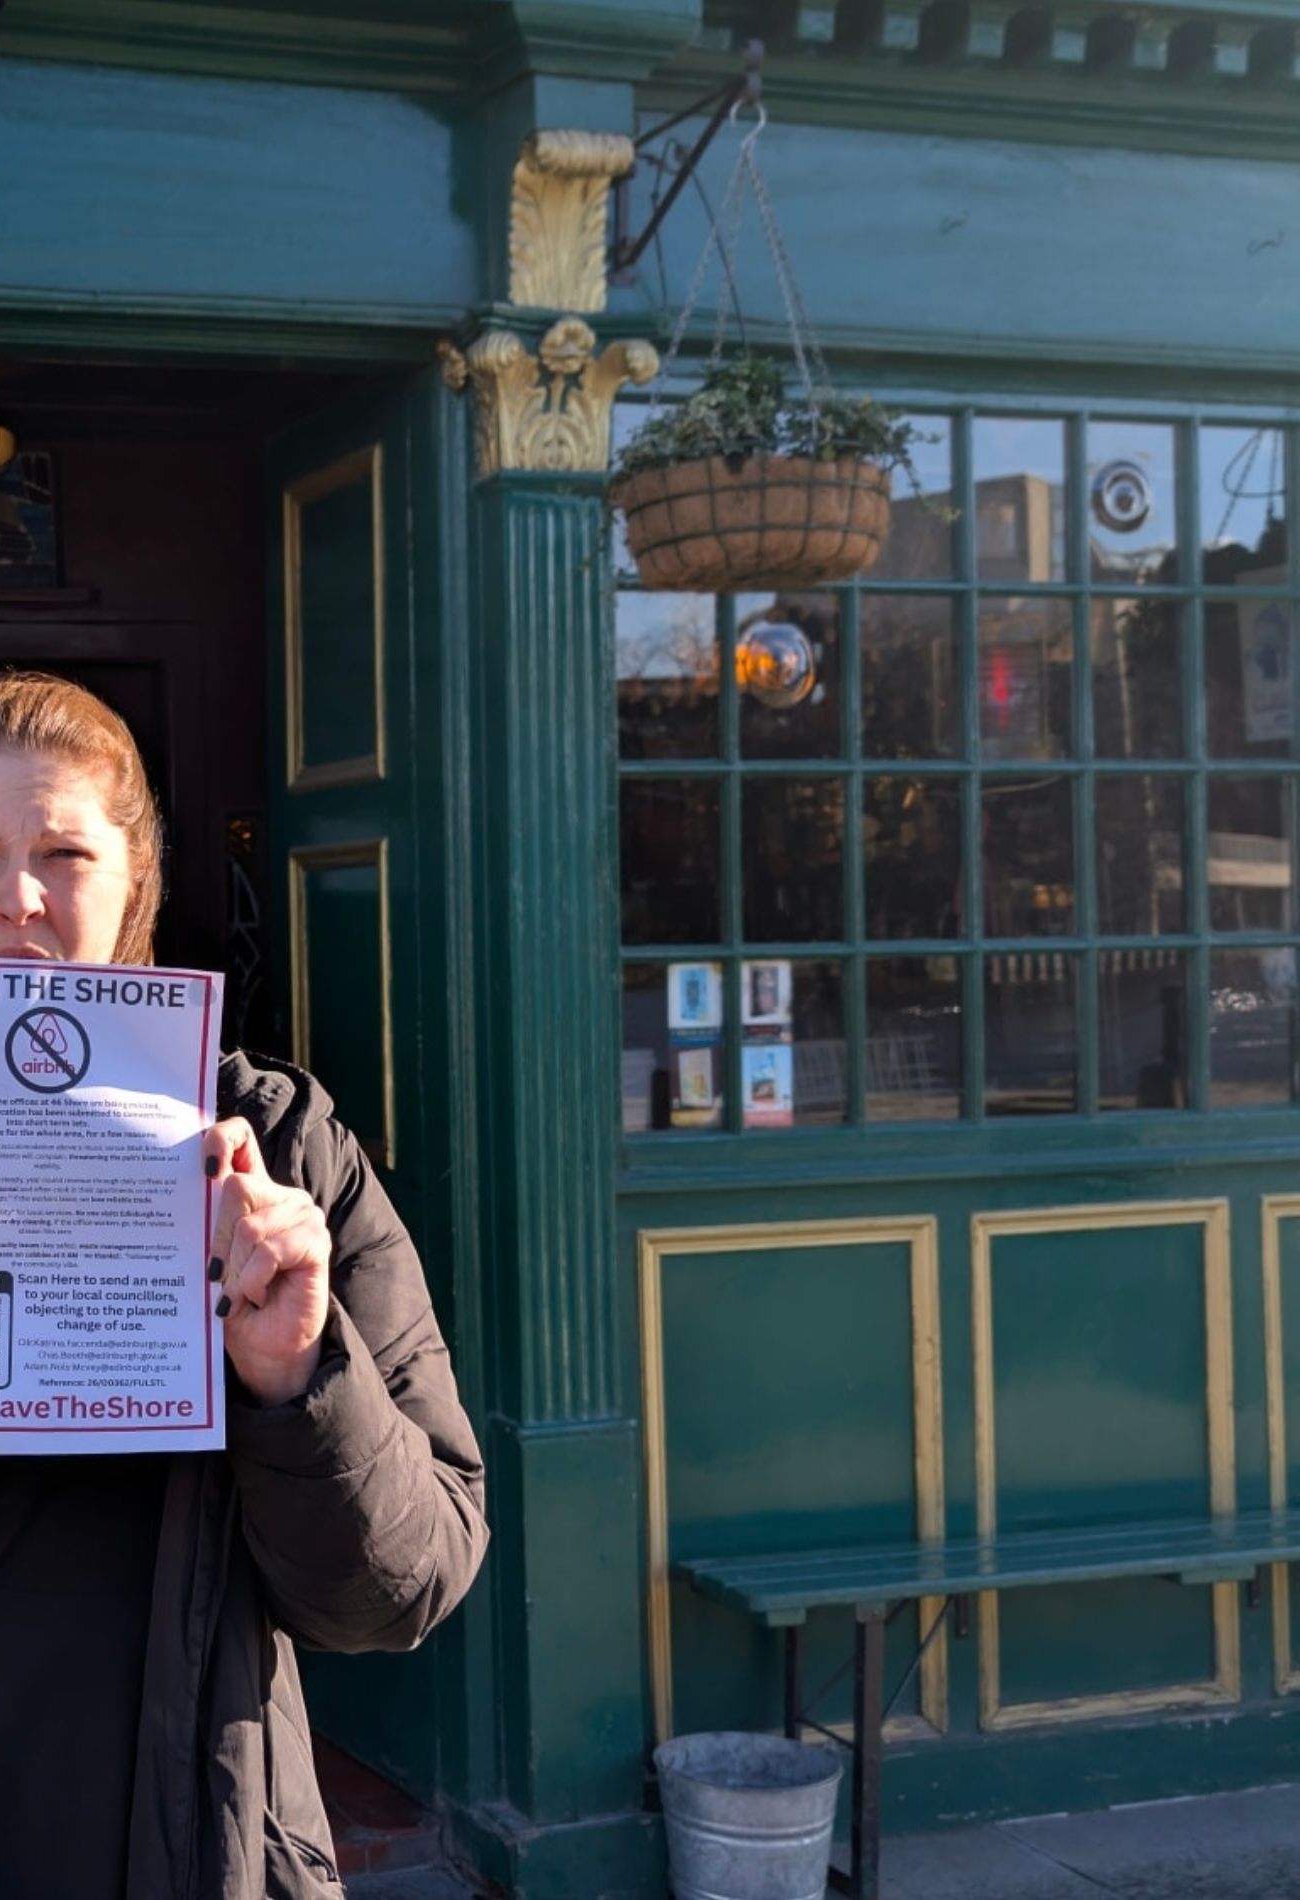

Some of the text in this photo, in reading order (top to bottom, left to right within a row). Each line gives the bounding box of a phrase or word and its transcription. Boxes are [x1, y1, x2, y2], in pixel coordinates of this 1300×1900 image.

[4, 974, 66, 1001] THE
[75, 977, 186, 1008] SHORE
[18, 1274, 185, 1287] Scan Here to send an email
[25, 1290, 178, 1303] to your local councillors,
[25, 1304, 177, 1318] objecting to the planned
[57, 1319, 145, 1332] change of use.
[39, 1379, 85, 1387] Reference:
